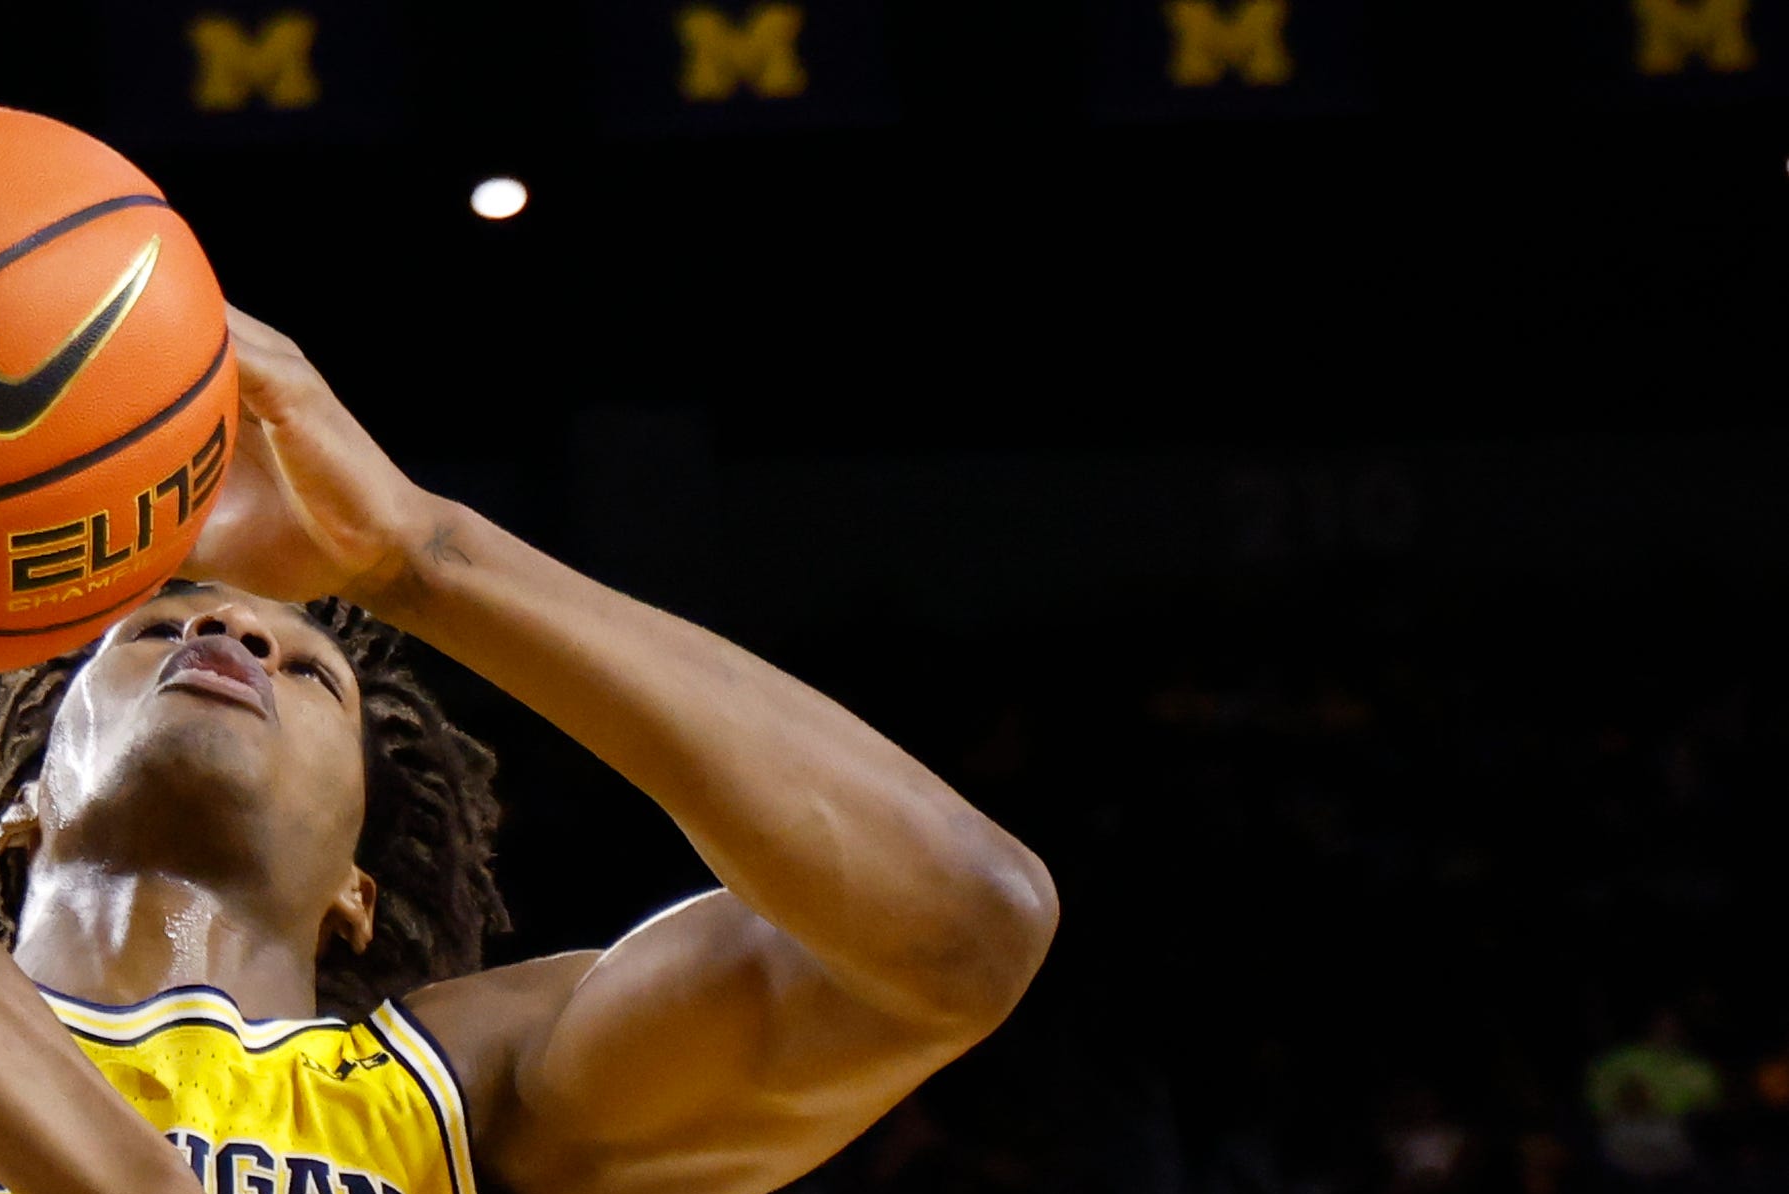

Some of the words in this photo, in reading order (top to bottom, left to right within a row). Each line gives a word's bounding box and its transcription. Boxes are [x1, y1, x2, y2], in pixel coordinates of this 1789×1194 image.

[190, 14, 317, 109] M
[678, 4, 806, 99] M
[1168, 0, 1289, 86] M
[1635, 0, 1751, 72] M
[8, 414, 227, 592] ELITE
